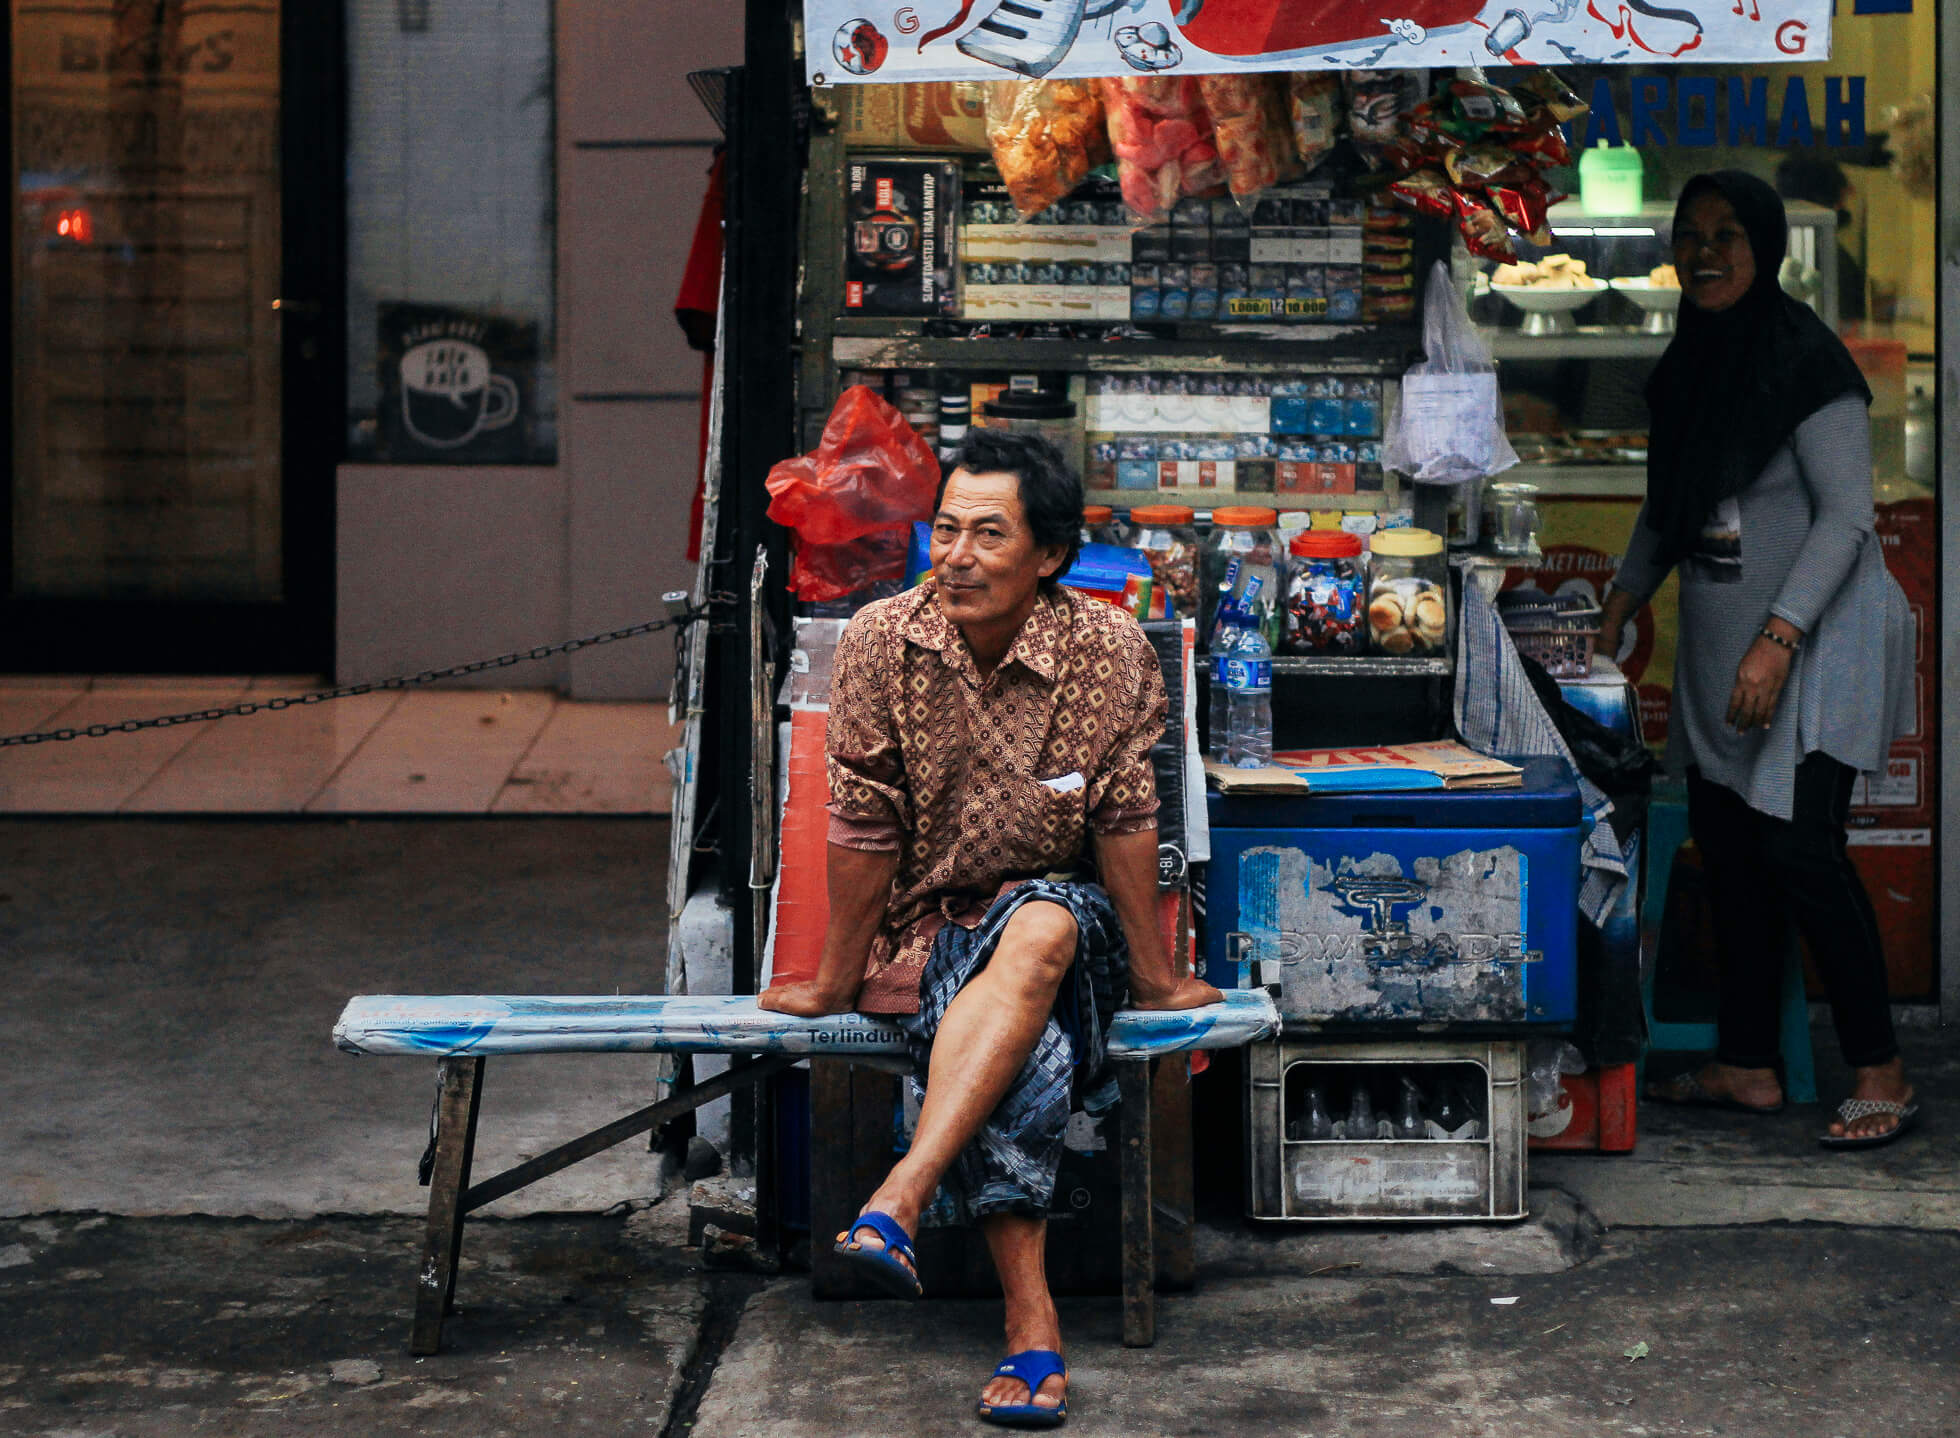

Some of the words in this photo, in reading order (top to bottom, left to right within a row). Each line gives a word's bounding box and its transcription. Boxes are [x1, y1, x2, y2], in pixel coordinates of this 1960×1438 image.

[1775, 20, 1808, 54] G
[924, 173, 936, 209] MANTAP
[924, 211, 935, 233] RASA
[923, 240, 934, 276] TOASTED
[850, 284, 861, 304] NEW
[922, 278, 933, 302] SLOW
[1159, 856, 1173, 875] 18+
[1226, 931, 1527, 963] POWERADE
[807, 1027, 905, 1044] Terlindun
